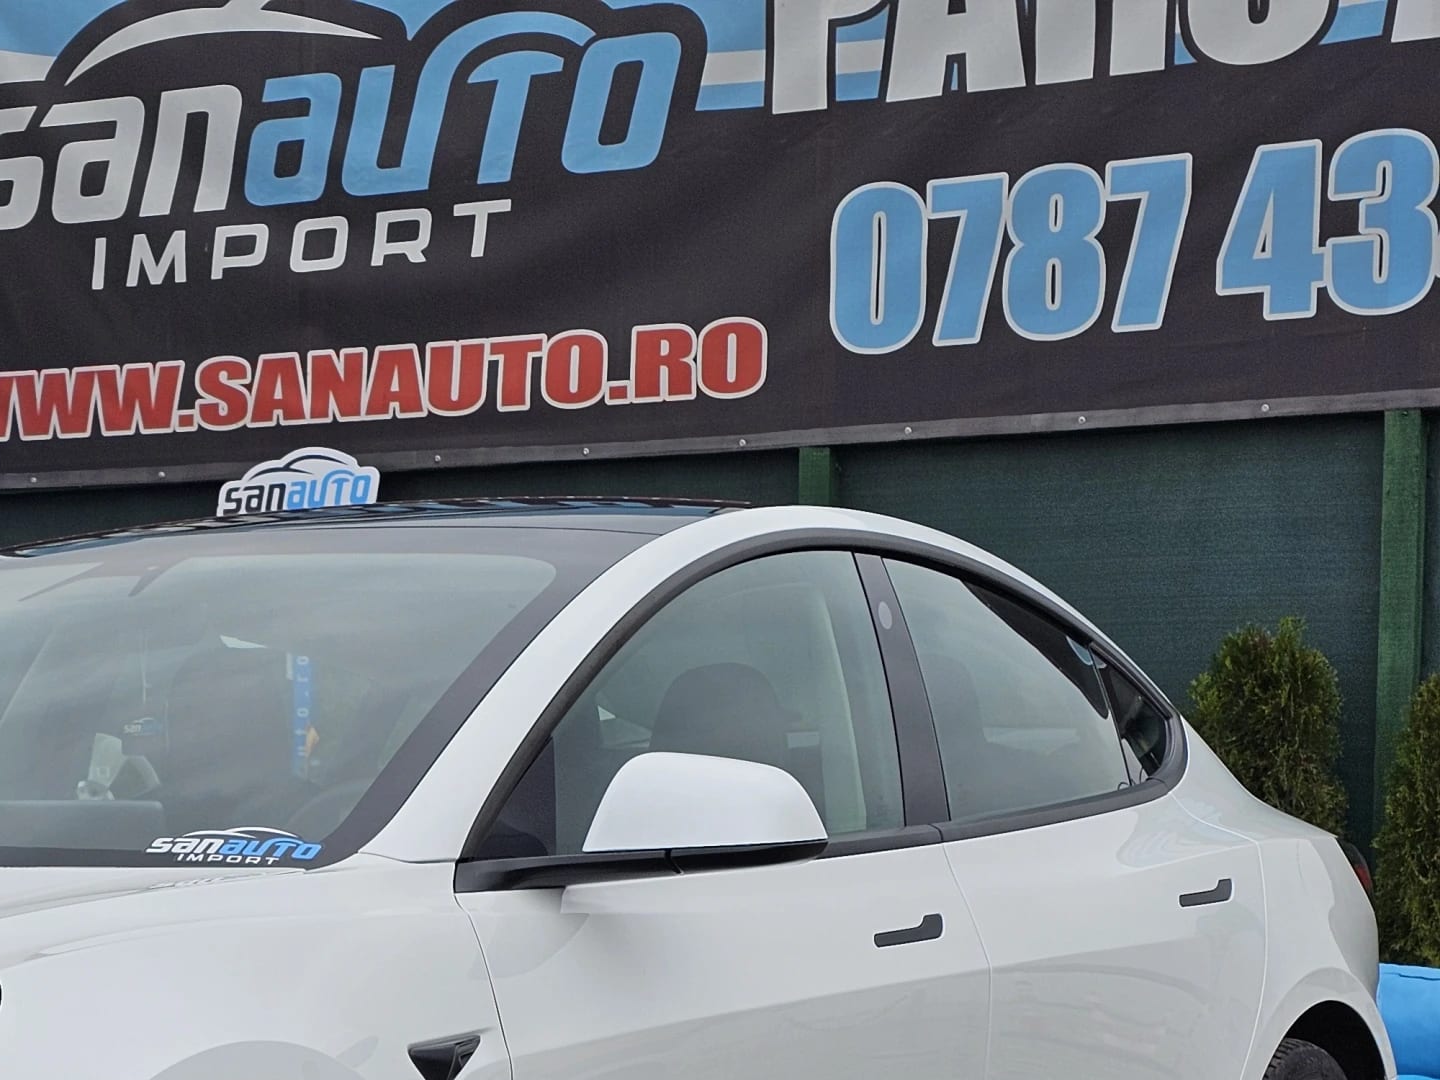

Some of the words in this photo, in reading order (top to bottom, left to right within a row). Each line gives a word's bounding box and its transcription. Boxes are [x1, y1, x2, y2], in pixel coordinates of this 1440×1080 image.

[91, 199, 513, 290] IMPORT
[829, 152, 1193, 355] 0787
[1215, 128, 1440, 321] 43
[176, 854, 280, 865] IMPORT
